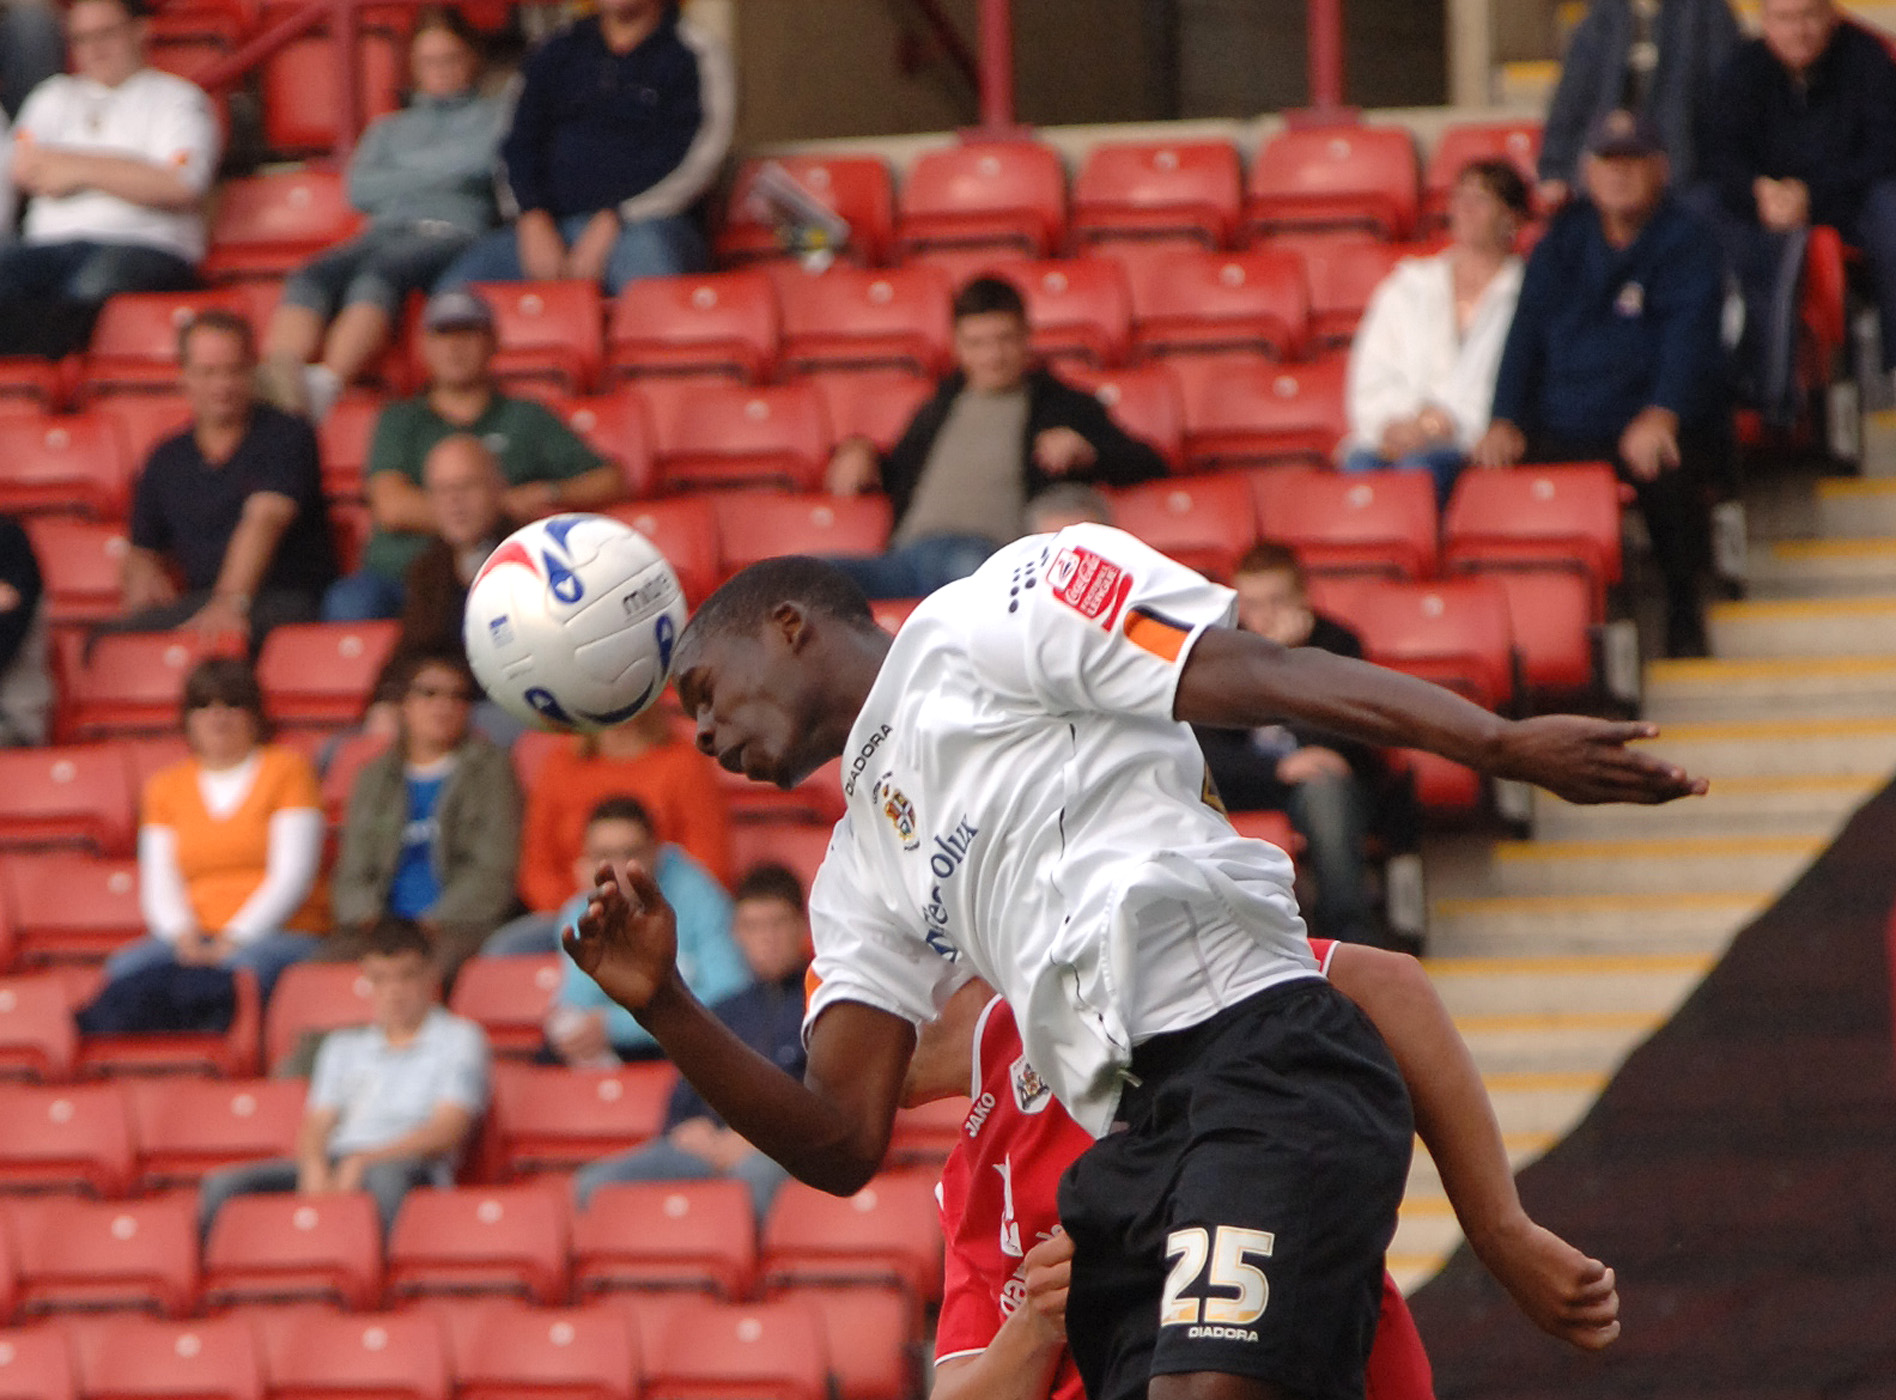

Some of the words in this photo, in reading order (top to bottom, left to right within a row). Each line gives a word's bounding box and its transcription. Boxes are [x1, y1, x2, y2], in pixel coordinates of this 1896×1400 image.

[845, 724, 893, 797] DIADORA
[965, 1092, 996, 1138] JAKO
[1161, 1225, 1275, 1327] 25
[1188, 1326, 1259, 1342] DIADORA
